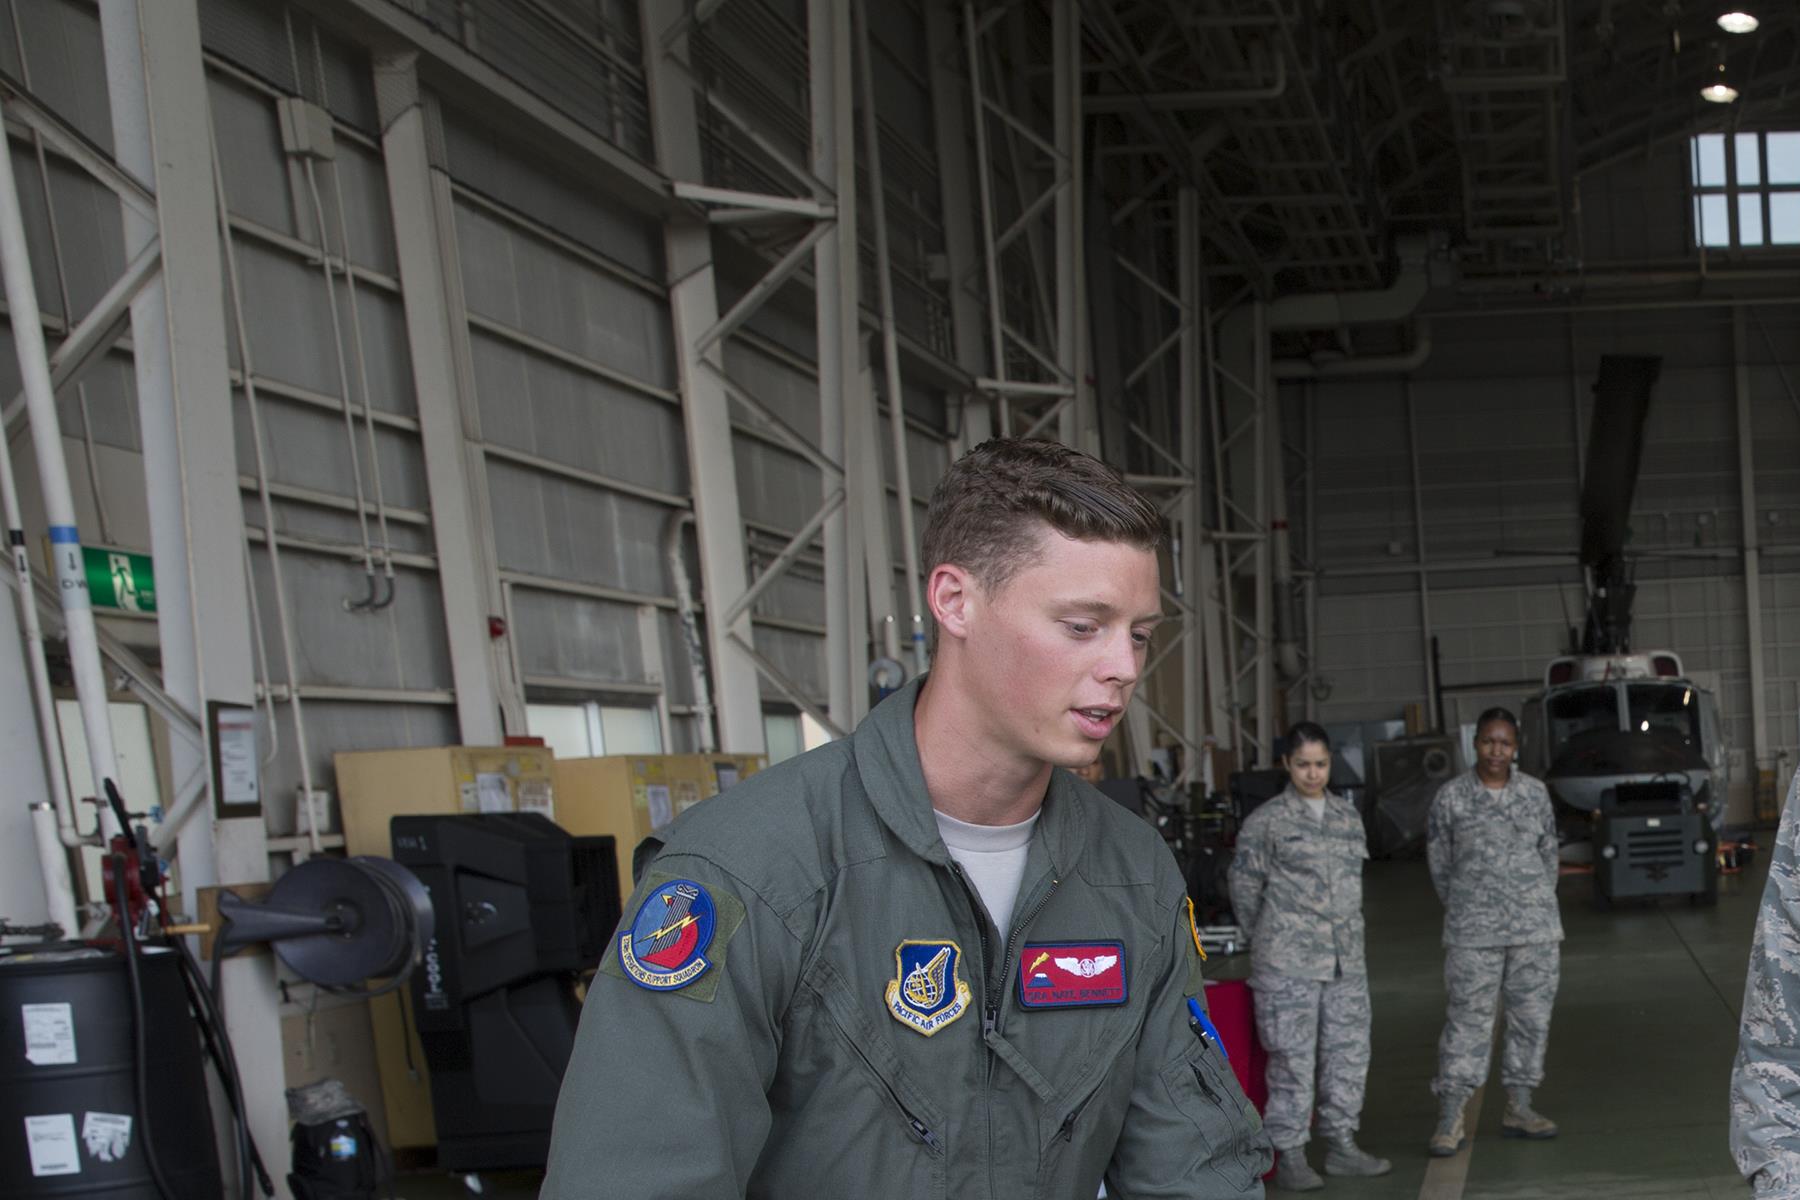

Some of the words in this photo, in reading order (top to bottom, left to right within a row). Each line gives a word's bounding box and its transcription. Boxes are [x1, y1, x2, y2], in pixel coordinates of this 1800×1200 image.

[647, 974, 673, 985] SUPPORT
[673, 961, 705, 984] SQUADRON
[893, 1001, 919, 1025] PACIFIC
[920, 1019, 935, 1030] AIR
[936, 1002, 962, 1025] FORCES
